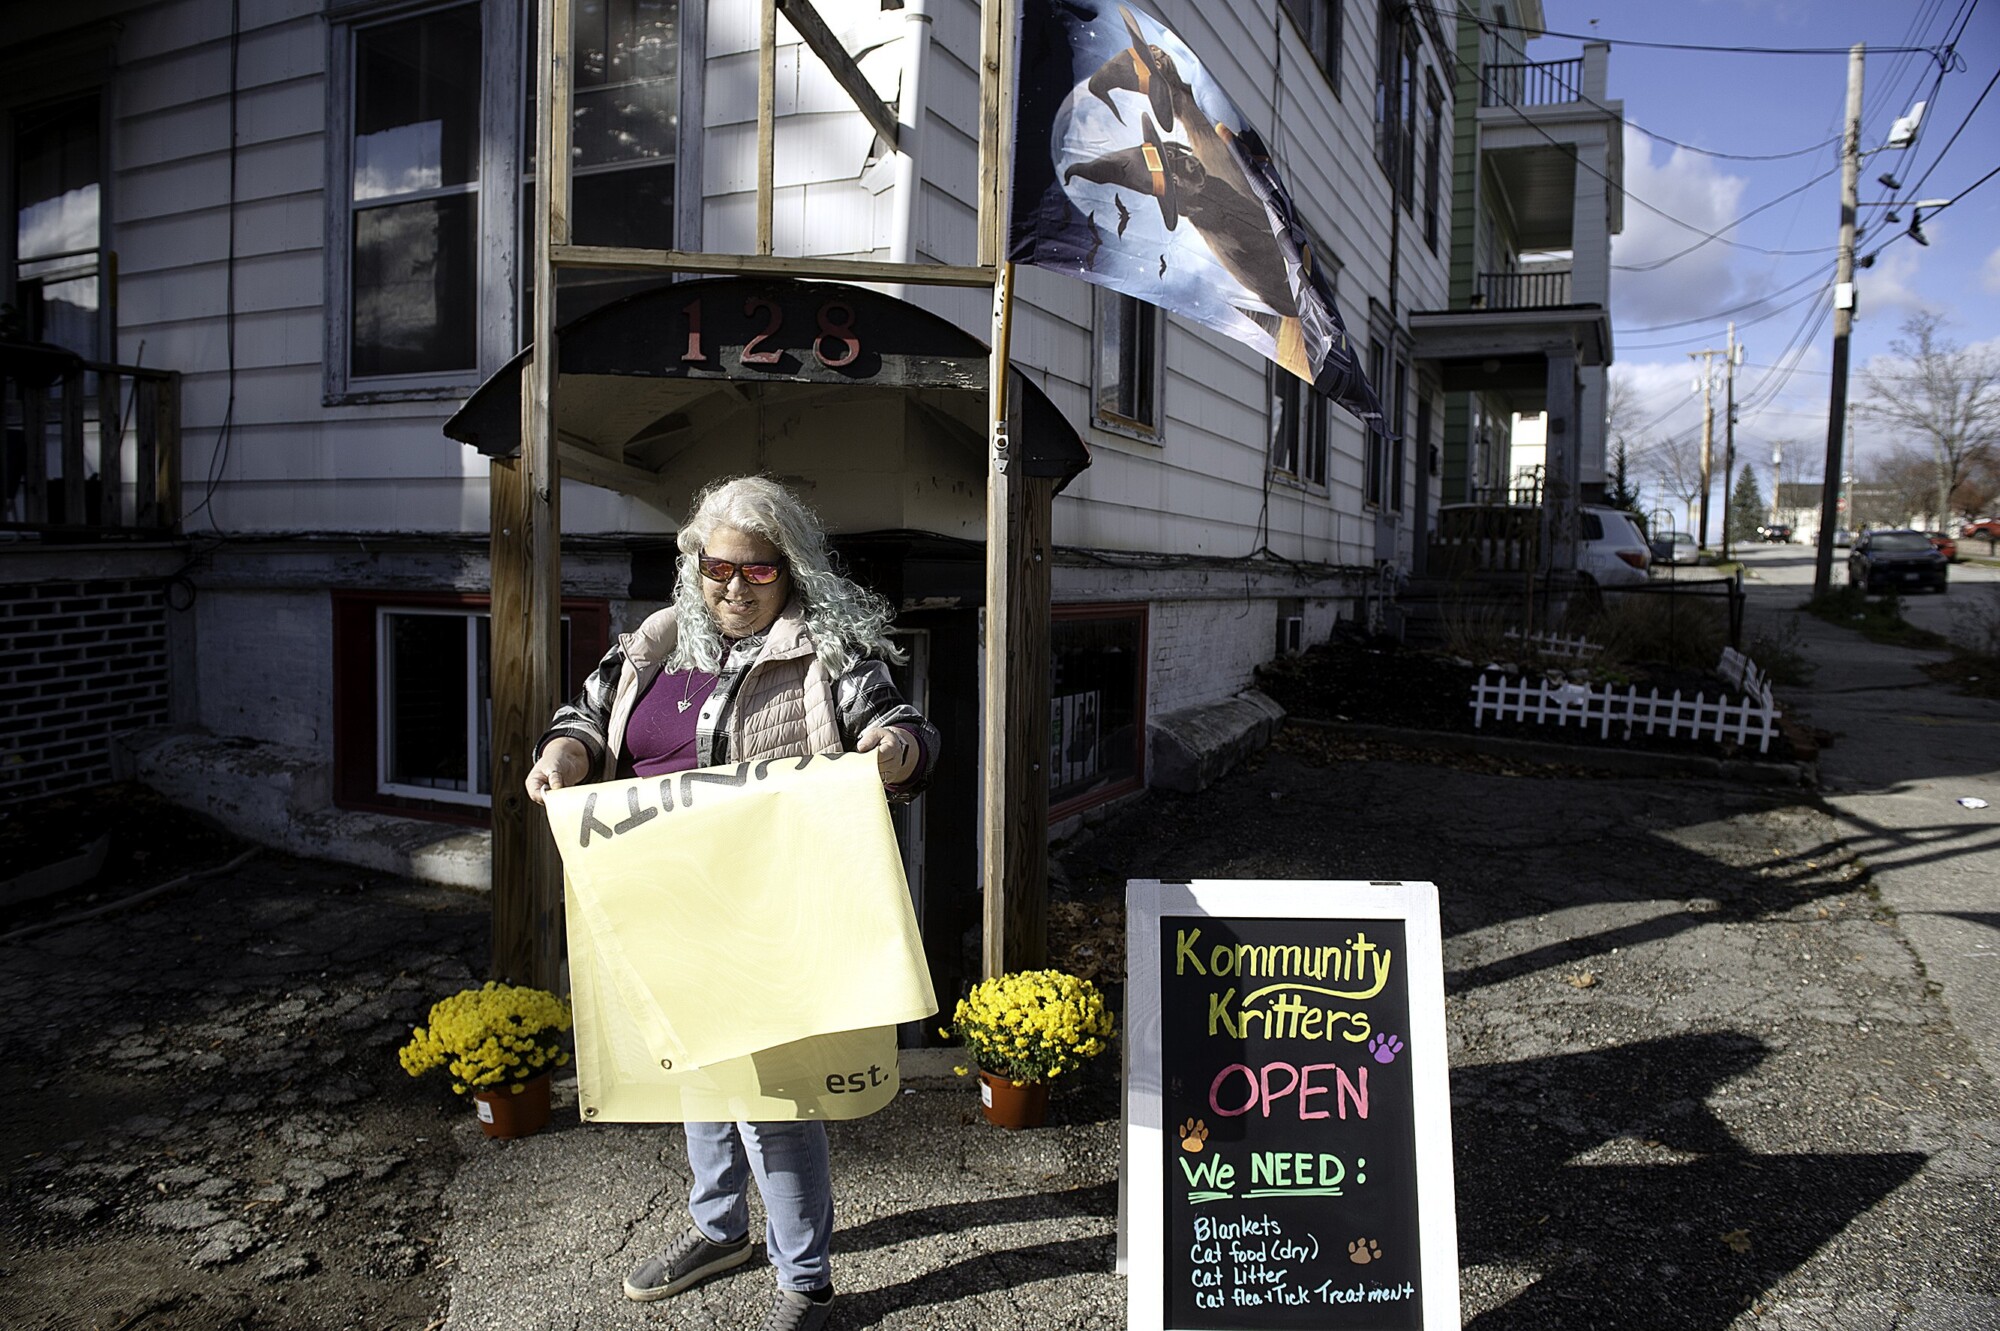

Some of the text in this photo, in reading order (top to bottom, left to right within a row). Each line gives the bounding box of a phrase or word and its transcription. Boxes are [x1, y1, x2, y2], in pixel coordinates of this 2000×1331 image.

[681, 299, 860, 366] 128
[1176, 927, 1391, 999] Kommunity
[1209, 988, 1371, 1042] Kritters
[826, 1064, 889, 1094] est.
[1209, 1061, 1369, 1120] OPEN
[1179, 1153, 1236, 1190] We
[1194, 1214, 1281, 1242] Blankets
[1190, 1240, 1222, 1264] Cat
[1191, 1264, 1288, 1287] Cat Litter
[1195, 1289, 1225, 1309] Cat
